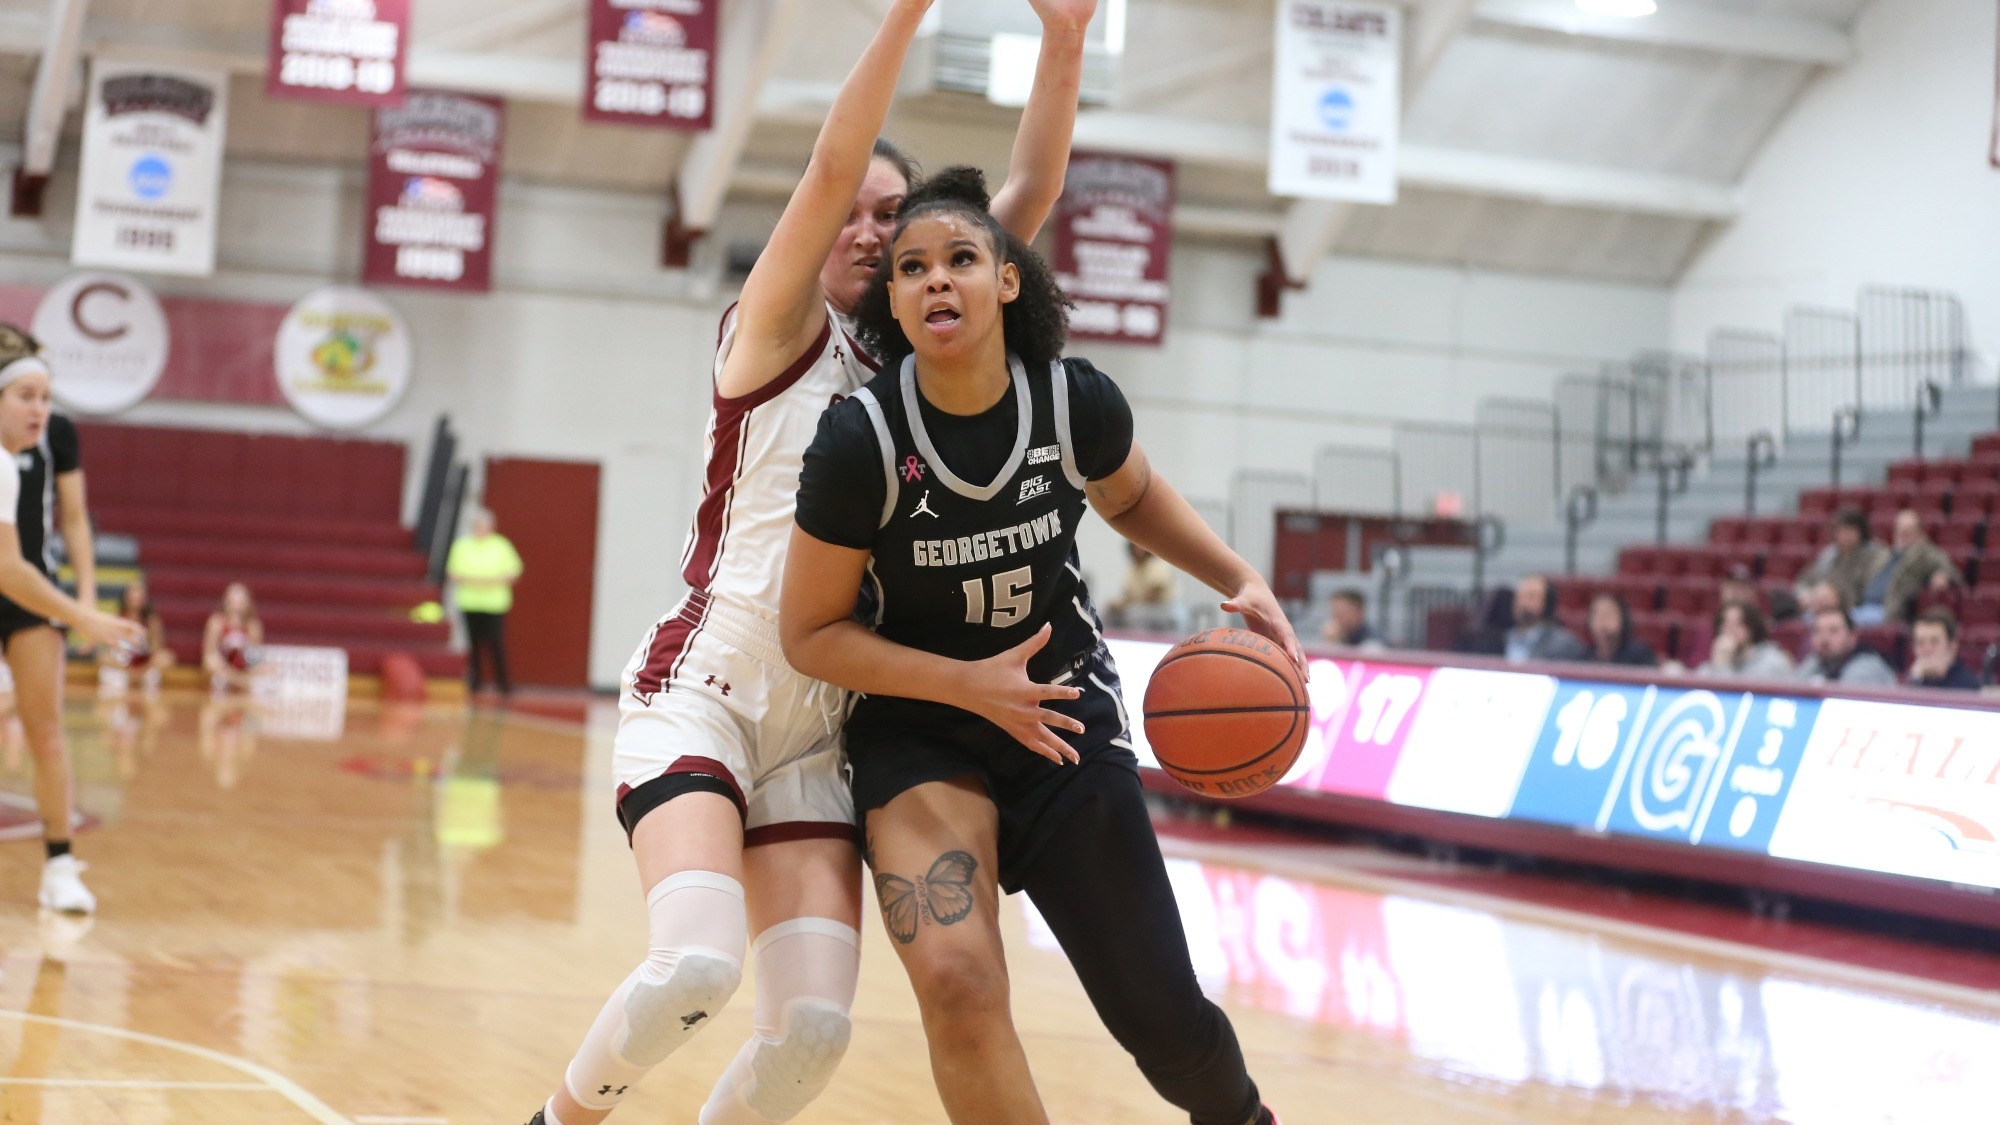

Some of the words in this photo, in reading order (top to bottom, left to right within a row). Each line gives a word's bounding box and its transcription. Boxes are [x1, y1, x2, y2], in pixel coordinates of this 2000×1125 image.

[71, 281, 132, 342] C
[1020, 475, 1044, 491] BIG
[1028, 453, 1061, 466] CHANGE
[1018, 481, 1052, 500] EAST
[913, 509, 1062, 567] GEORGETOWN
[962, 565, 1033, 629] 15
[1352, 672, 1422, 745] 17
[1552, 690, 1628, 770] 16
